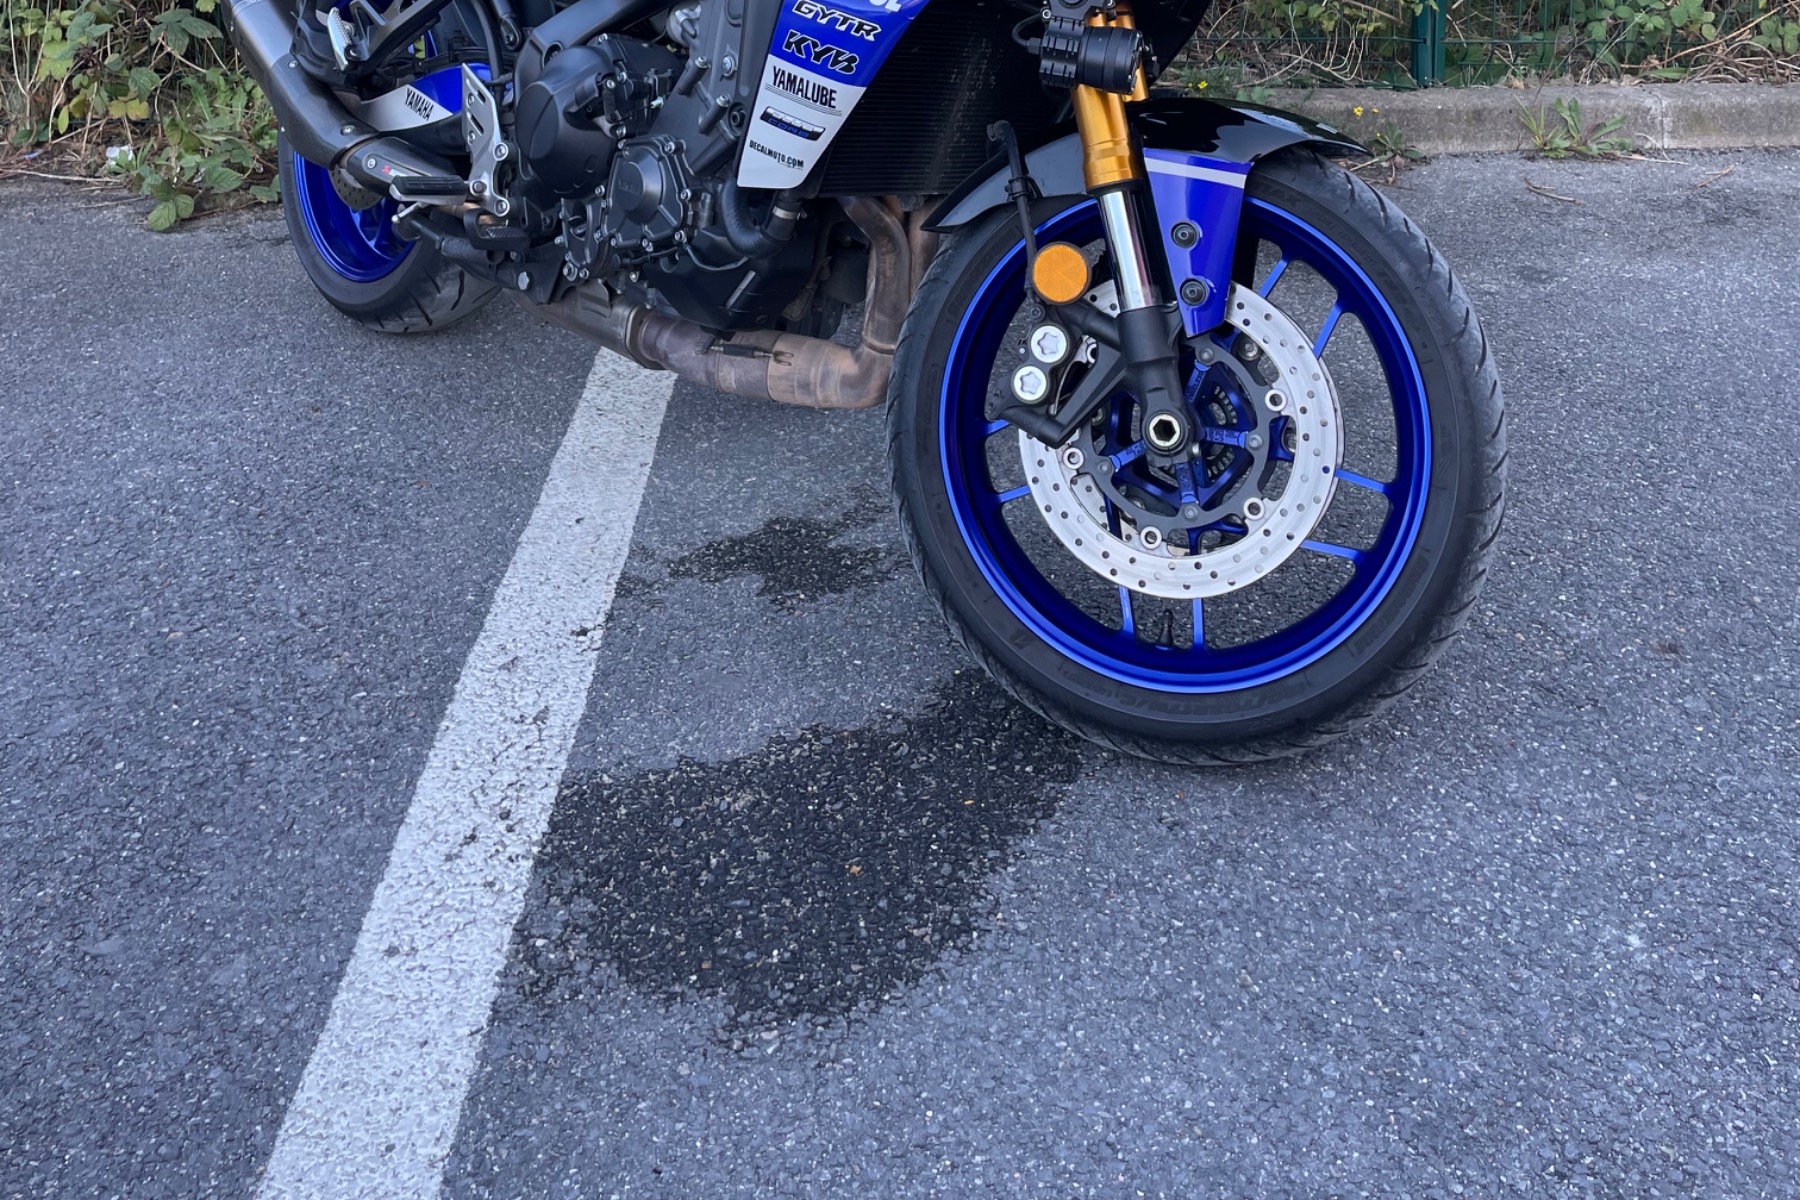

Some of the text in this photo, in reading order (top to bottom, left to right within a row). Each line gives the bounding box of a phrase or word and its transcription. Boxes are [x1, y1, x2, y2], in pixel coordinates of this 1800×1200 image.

[783, 30, 859, 75] KYB
[405, 88, 434, 121] YAMAHA
[773, 66, 837, 109] YAMALUBE
